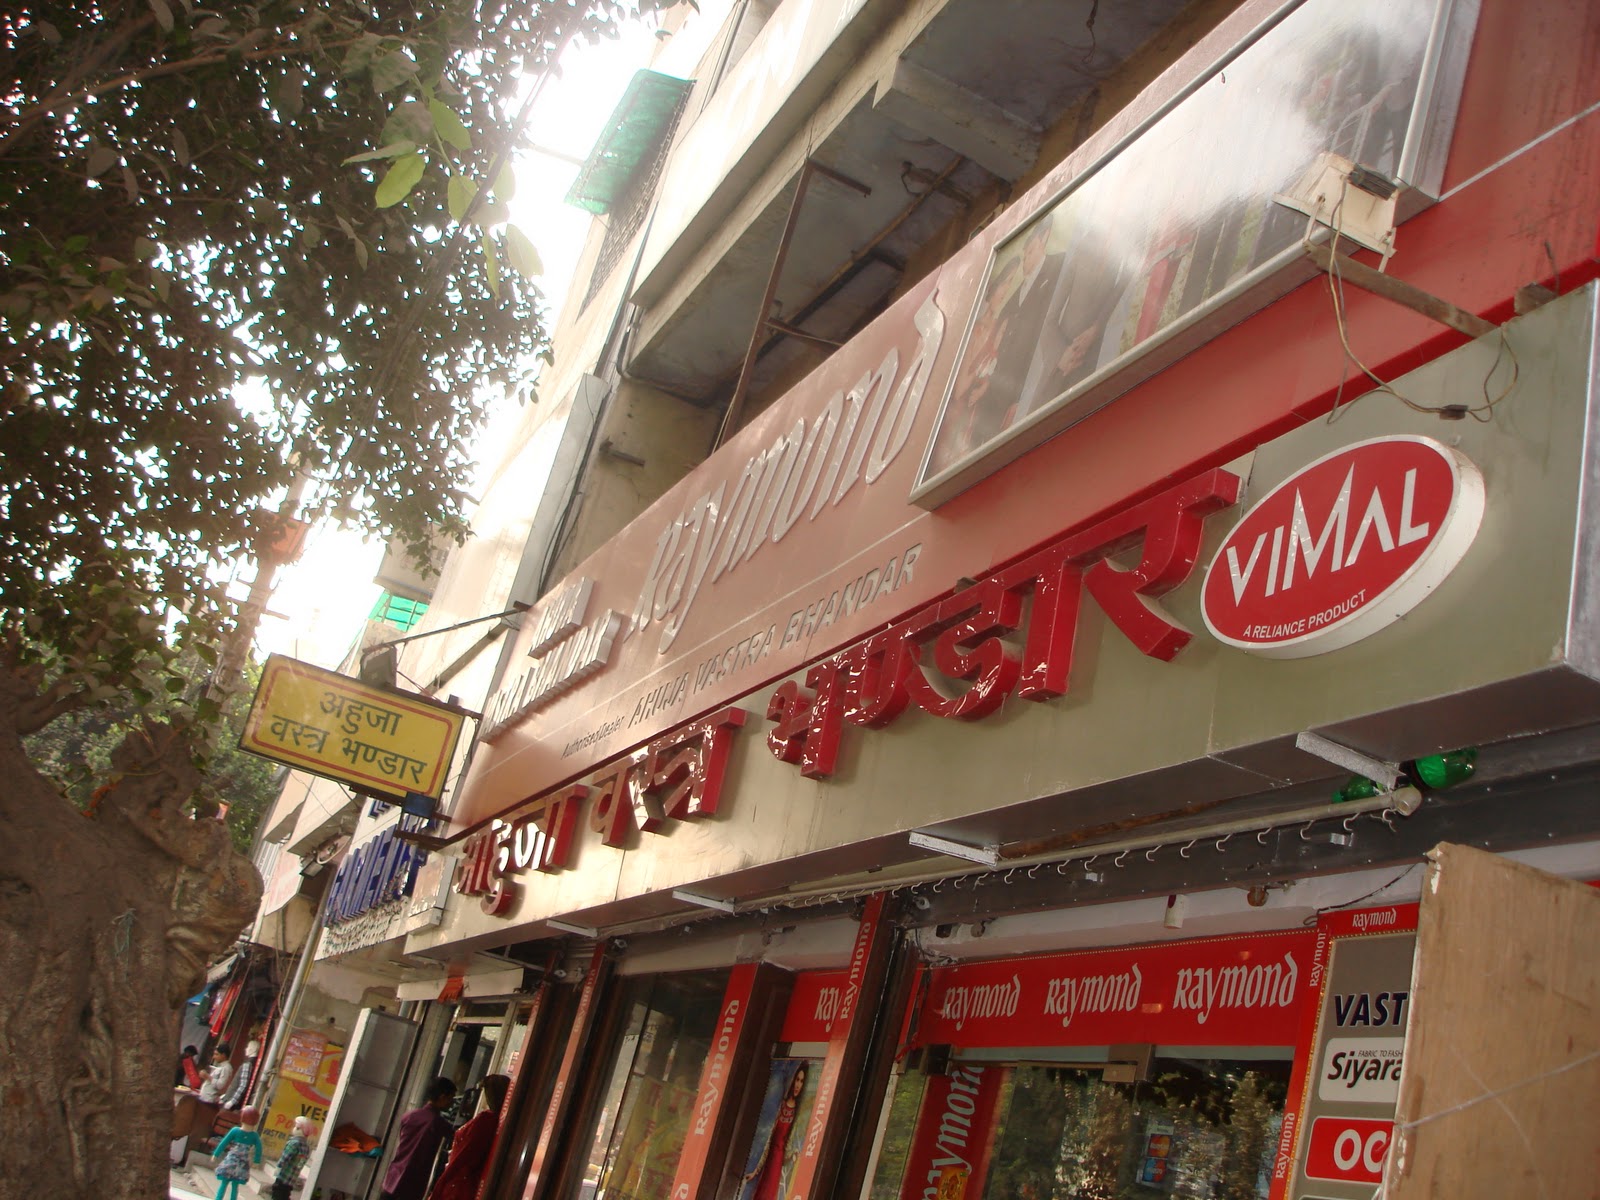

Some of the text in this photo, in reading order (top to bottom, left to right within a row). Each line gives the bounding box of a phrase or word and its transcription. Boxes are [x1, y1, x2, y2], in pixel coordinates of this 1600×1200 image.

[624, 288, 945, 656] Raymond
[1226, 461, 1430, 607] VIMAL
[628, 543, 922, 729] AHUJA VASTRA BHANDAR
[766, 467, 1241, 781] भण्डार
[1243, 589, 1366, 639] A RELIANCE PRODUCT
[270, 714, 427, 785] वस्त्र भण्डार
[319, 690, 403, 736] अहुजा
[1352, 908, 1397, 931] Raymond
[841, 922, 872, 1020] Raymond
[942, 951, 1298, 1031] Raymond Raymond Raymond
[1334, 992, 1408, 1027] VAST
[694, 999, 739, 1135] Raymond
[1275, 1112, 1295, 1180] Raymond
